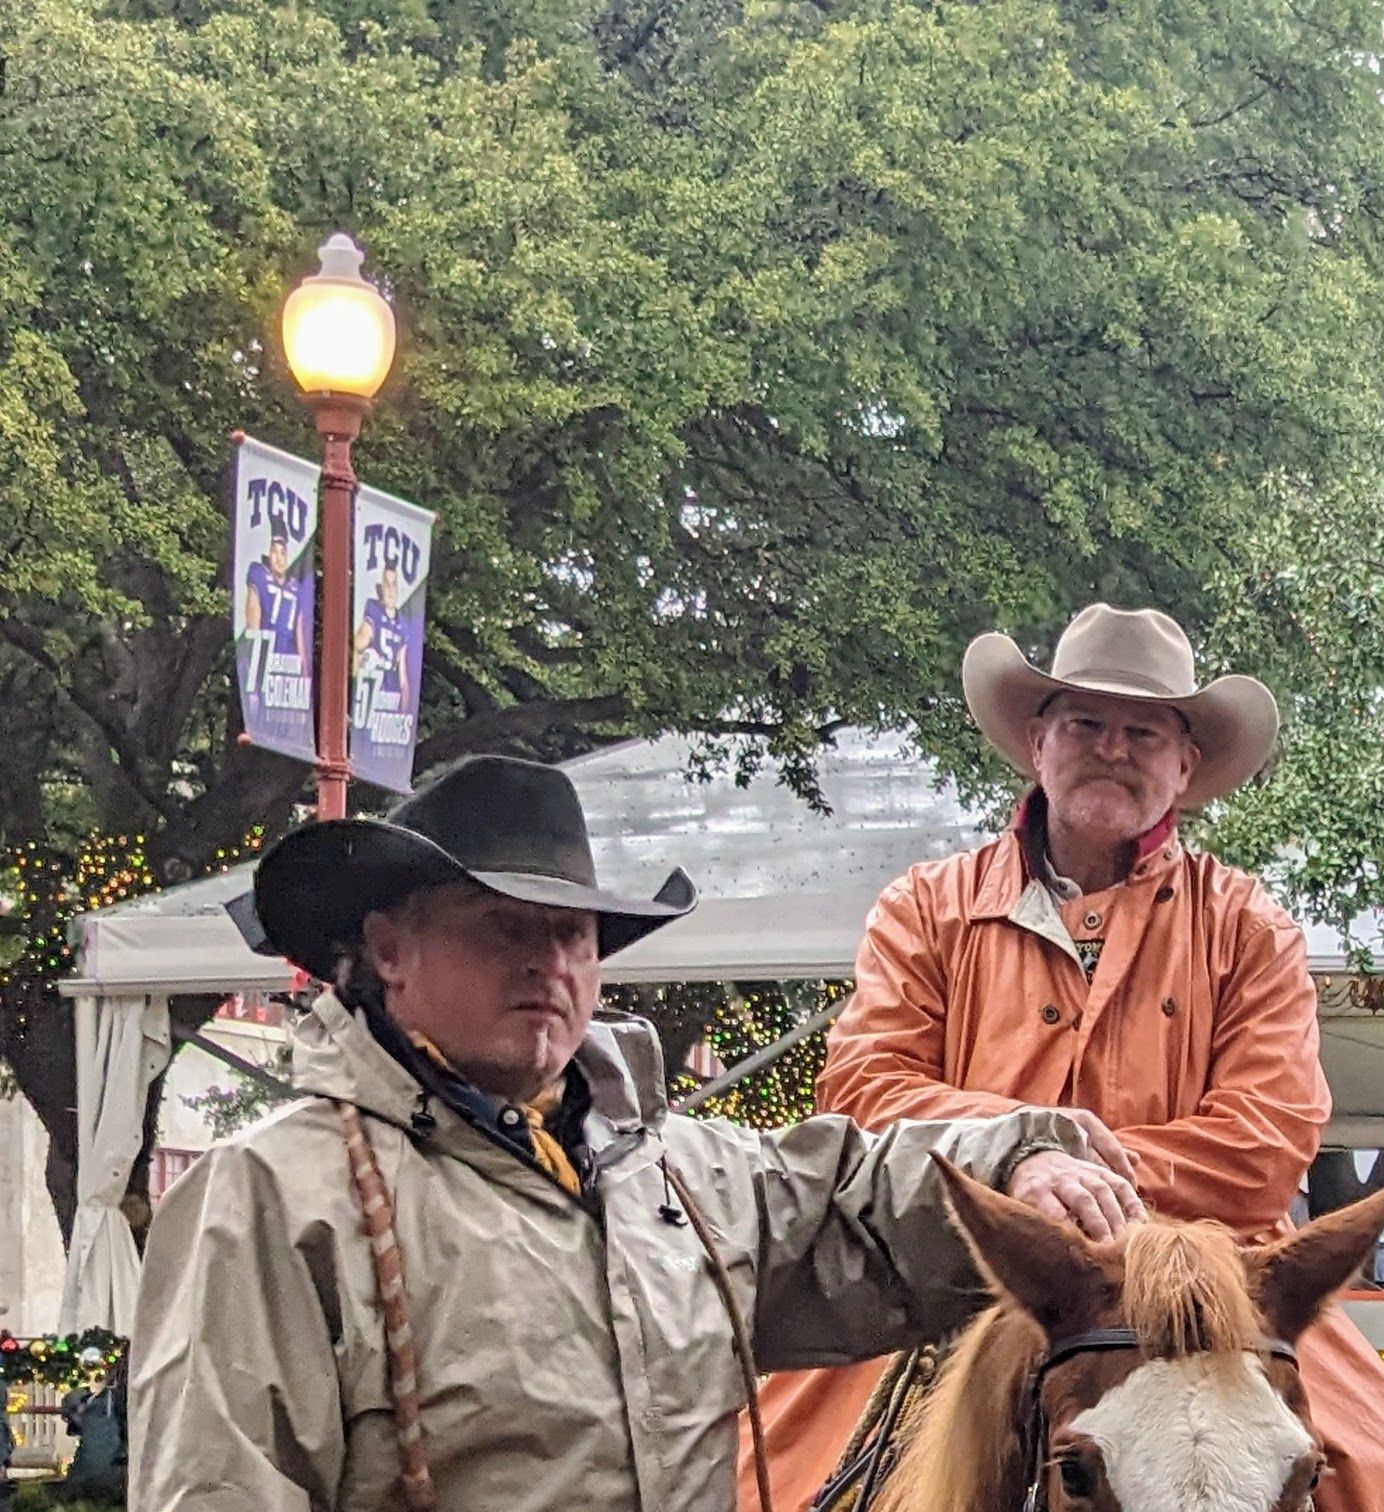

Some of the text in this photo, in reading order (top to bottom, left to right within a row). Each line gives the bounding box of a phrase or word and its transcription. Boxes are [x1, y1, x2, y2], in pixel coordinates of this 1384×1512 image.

[247, 478, 308, 544] TCU
[365, 523, 420, 586] TCU
[267, 585, 297, 631] 77
[244, 629, 277, 693] 77
[354, 667, 384, 729] 57
